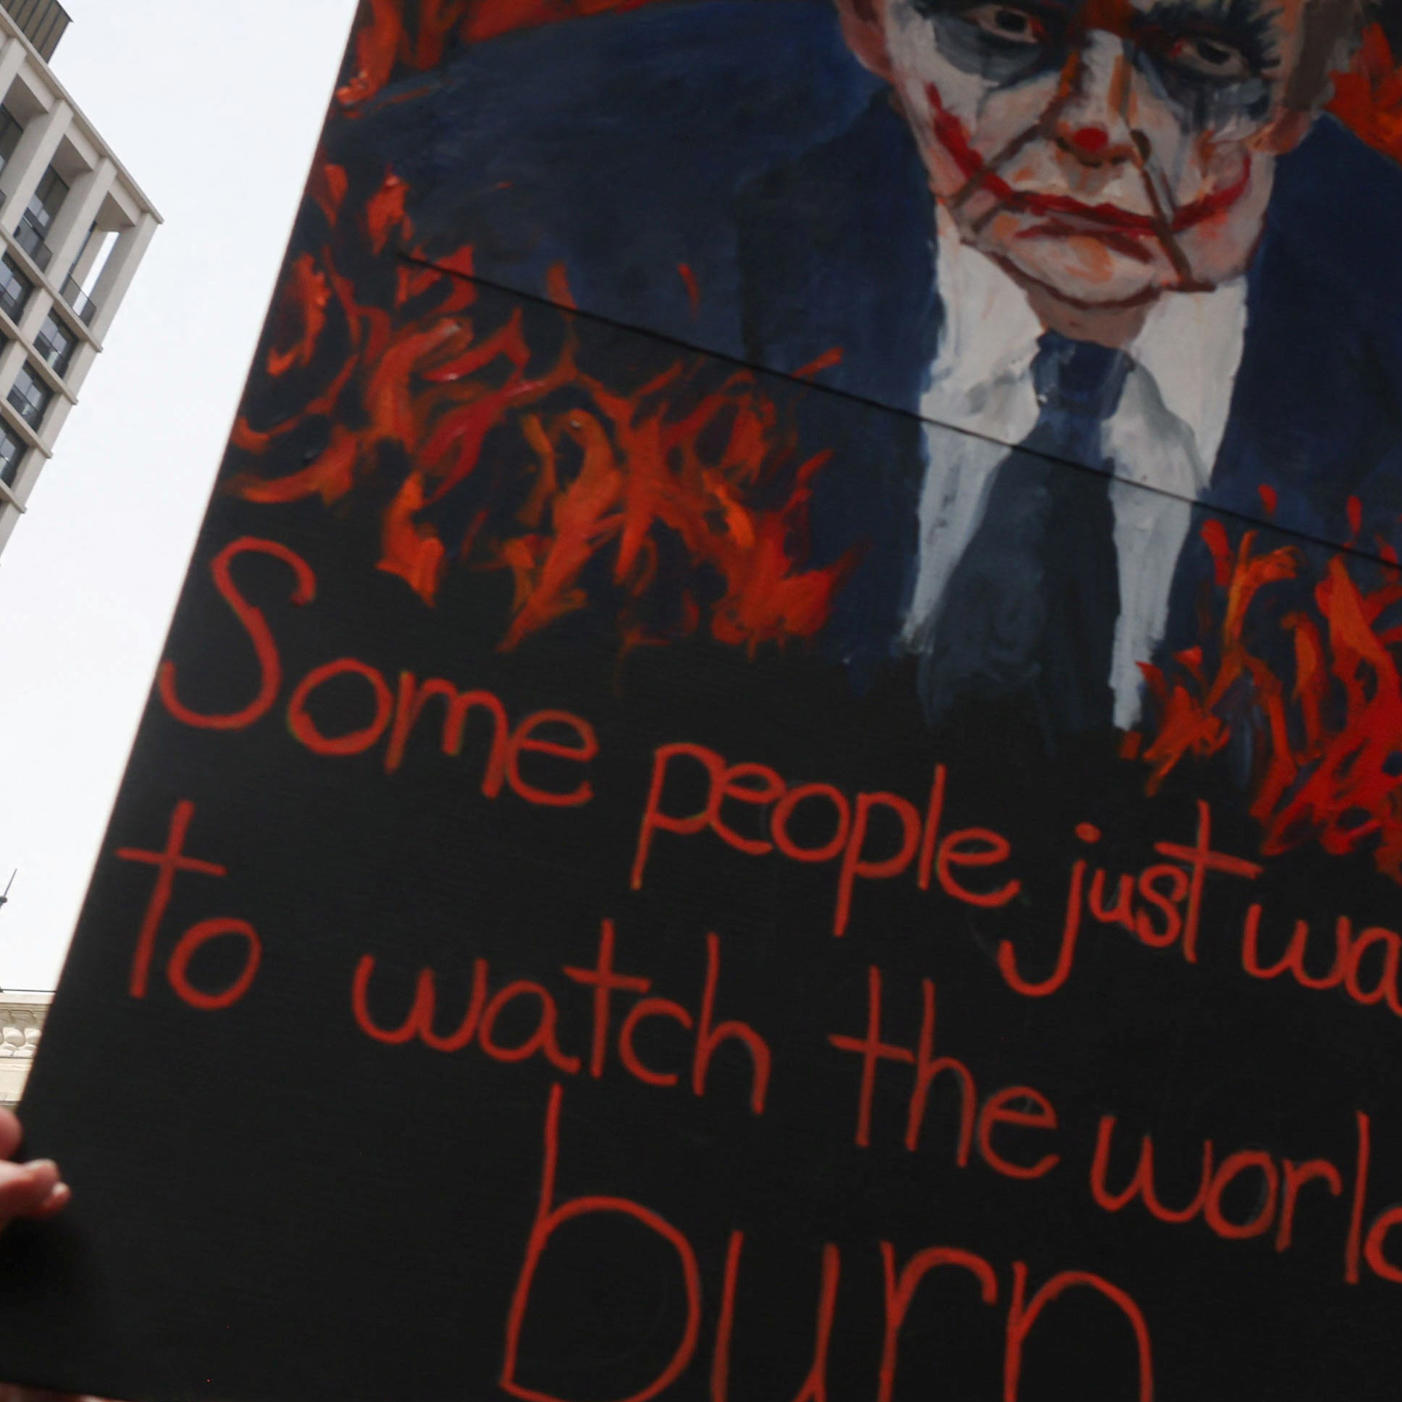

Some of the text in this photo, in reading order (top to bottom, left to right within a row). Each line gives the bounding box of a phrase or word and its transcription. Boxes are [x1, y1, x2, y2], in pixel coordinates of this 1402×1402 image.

[159, 536, 594, 806] Some
[117, 800, 261, 1008] to
[353, 917, 770, 1114] watch
[829, 968, 1060, 1181] the
[632, 742, 1019, 935] people
[1000, 799, 1260, 996] just
